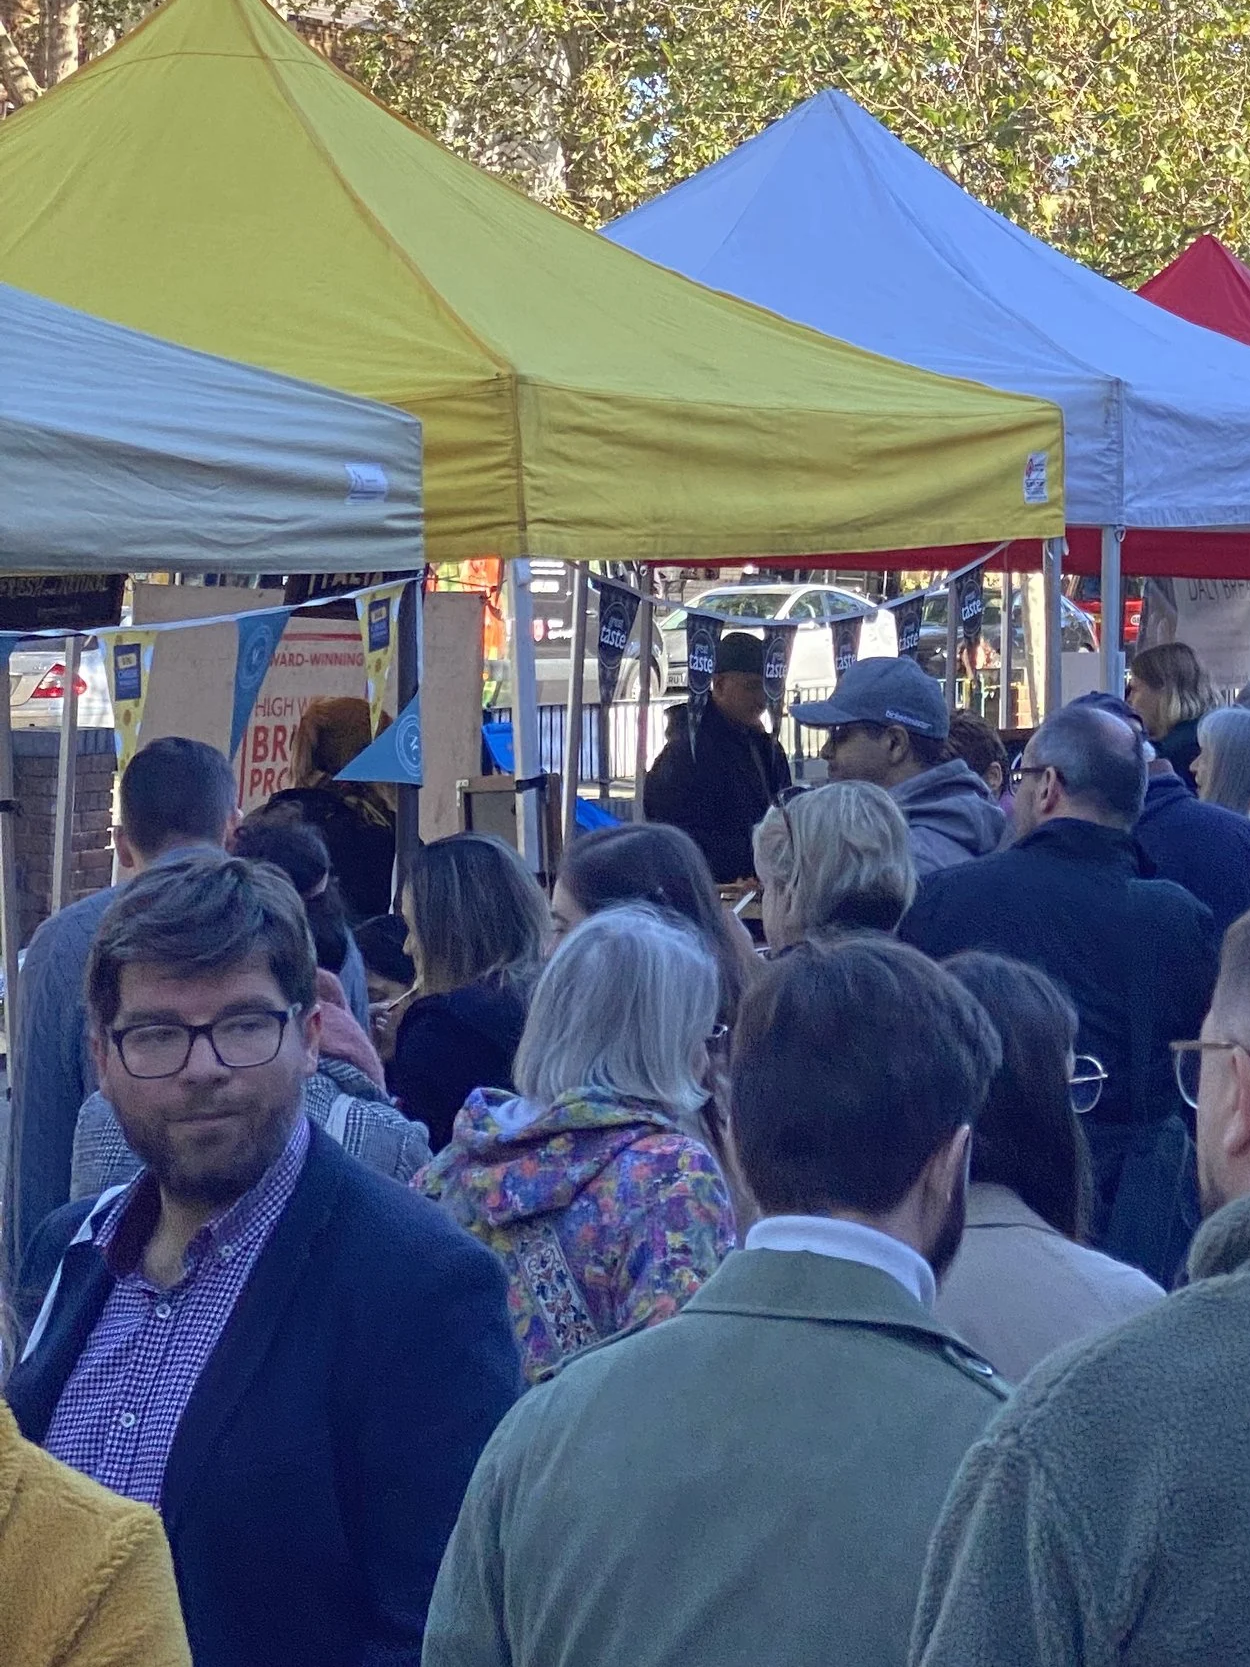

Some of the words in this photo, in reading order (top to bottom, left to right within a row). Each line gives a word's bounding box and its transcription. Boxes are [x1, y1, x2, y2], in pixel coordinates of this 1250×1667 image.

[961, 598, 984, 621] taste
[600, 625, 627, 650] taste
[269, 652, 364, 667] WARD-WINNING
[689, 653, 714, 674] taste
[765, 662, 788, 679] taste
[255, 697, 294, 718] HIGH
[252, 725, 300, 764] BR
